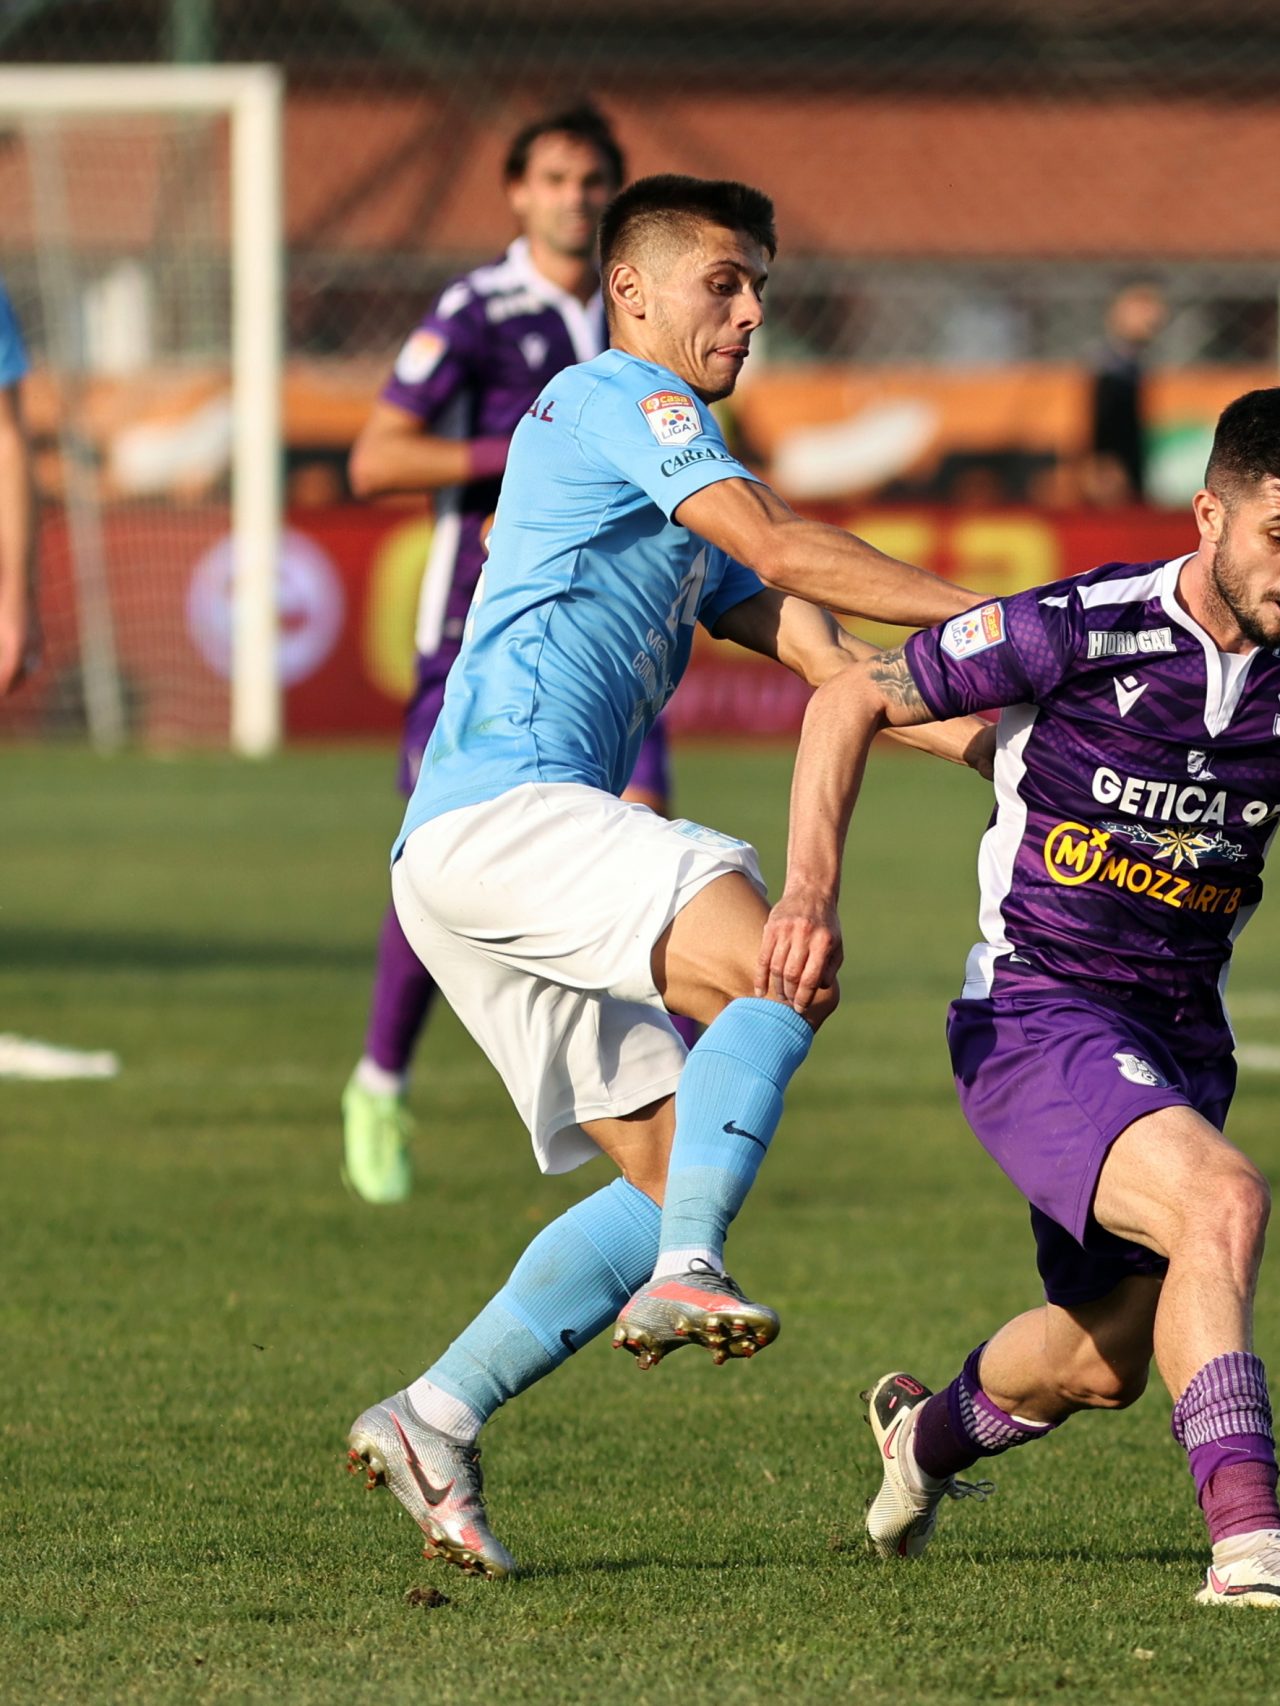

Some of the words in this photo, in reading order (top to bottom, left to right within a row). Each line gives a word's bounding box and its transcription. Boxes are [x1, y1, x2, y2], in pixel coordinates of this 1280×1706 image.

[661, 423, 692, 440] LIGA
[1091, 766, 1228, 826] GETICA
[1098, 856, 1226, 912] MOZZART
